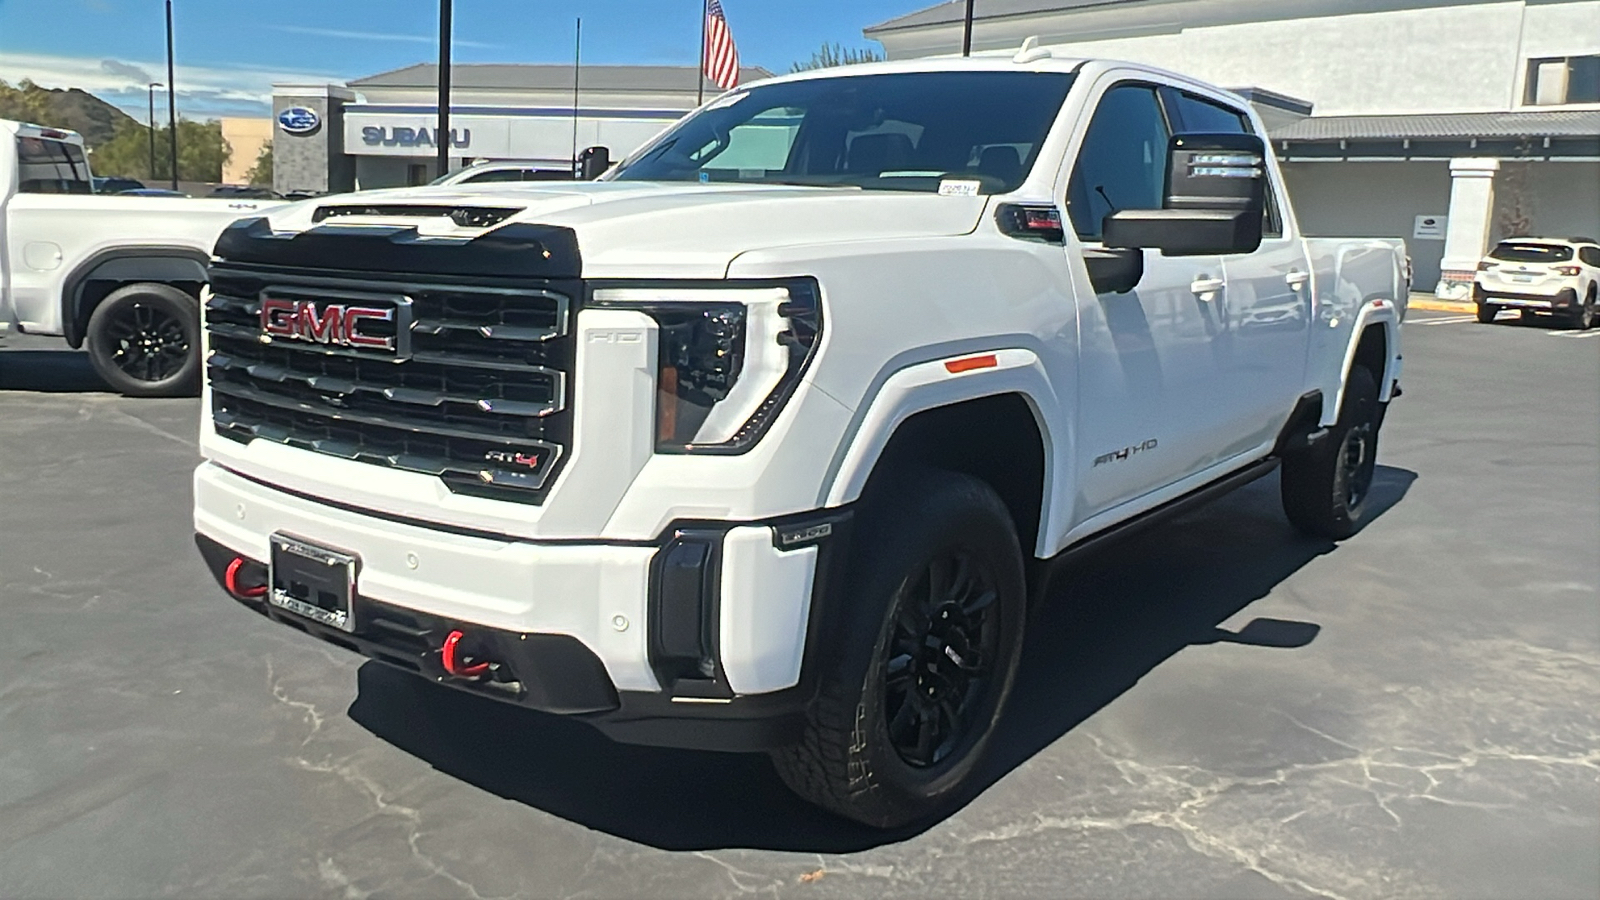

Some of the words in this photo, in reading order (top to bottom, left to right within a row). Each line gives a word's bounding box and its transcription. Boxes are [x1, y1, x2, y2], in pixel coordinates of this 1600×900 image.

[260, 299, 396, 351] GMC
[587, 332, 642, 343] HD
[1131, 437, 1159, 455] HD
